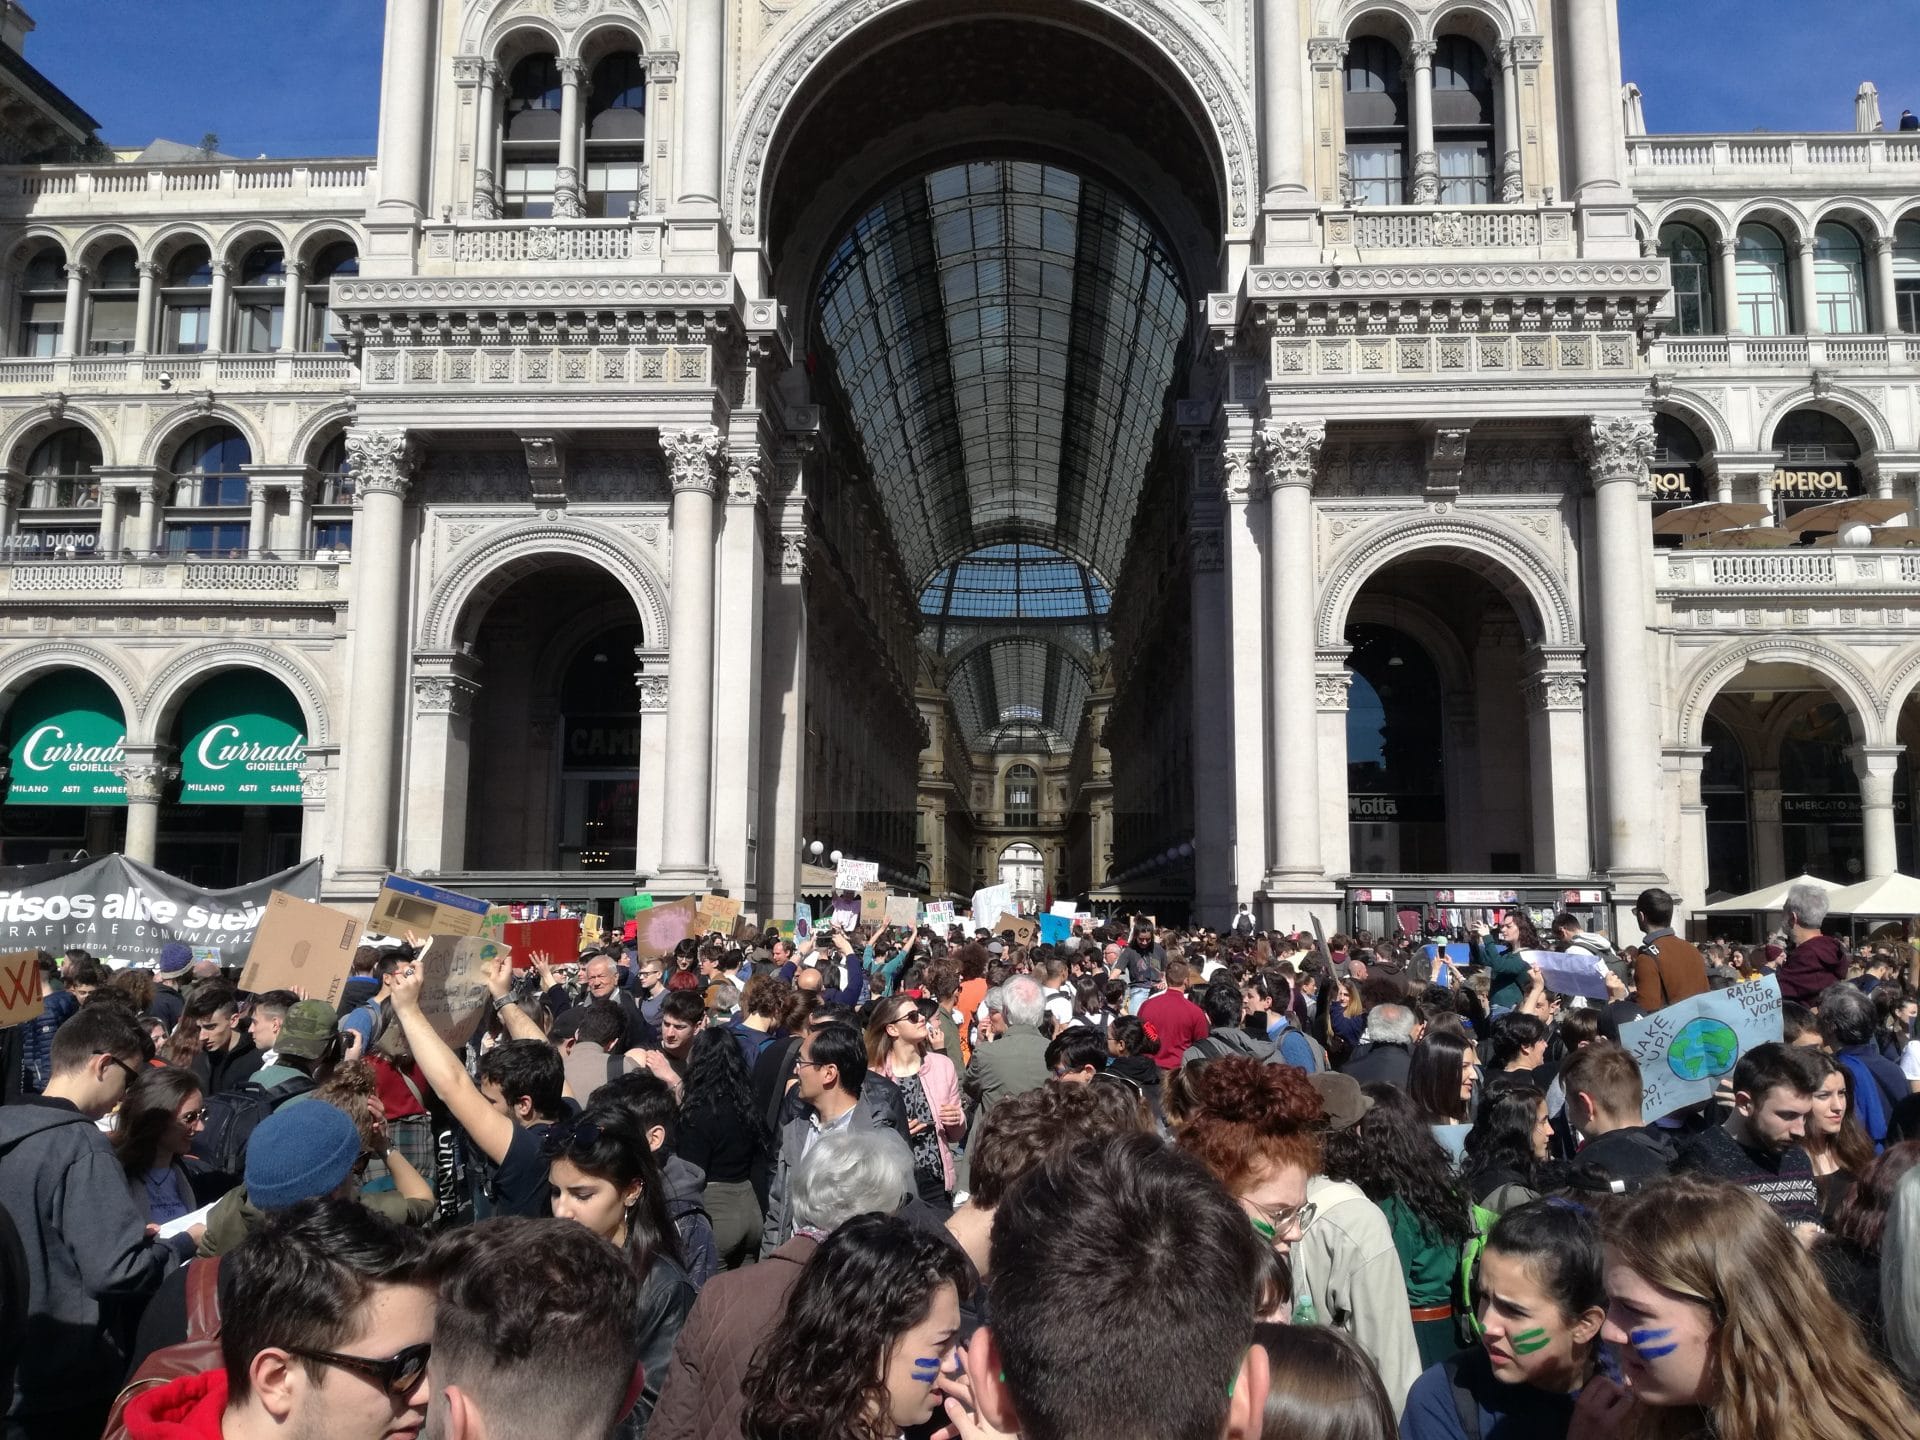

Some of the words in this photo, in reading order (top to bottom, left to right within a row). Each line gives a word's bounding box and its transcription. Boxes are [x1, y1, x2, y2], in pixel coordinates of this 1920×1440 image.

[1650, 473, 1691, 492] ROL
[1771, 469, 1849, 491] APEROL
[1652, 492, 1691, 500] AZZA
[1779, 490, 1849, 498] ERRAZZA
[3, 535, 40, 548] AZZA
[46, 534, 95, 547] DUOMO
[23, 725, 127, 771] Currad
[11, 784, 49, 793] MILANO
[61, 785, 81, 793] ASTI
[93, 785, 127, 794] SANRE
[187, 783, 226, 792] MILANO
[238, 784, 258, 793] ASTI
[270, 785, 304, 793] SANRE
[1348, 797, 1399, 815] Motta
[1784, 801, 1794, 810] IL
[1795, 800, 1847, 810] MERCATO
[102, 886, 178, 924] albe
[9, 923, 97, 937] RAFICA
[111, 923, 119, 935] E
[135, 925, 252, 944] COMUNICAZ
[1726, 980, 1763, 1000] RAISE
[1739, 988, 1773, 1009] YOUR
[1750, 998, 1782, 1017] VOICE
[438, 1130, 456, 1217] GUINNE
